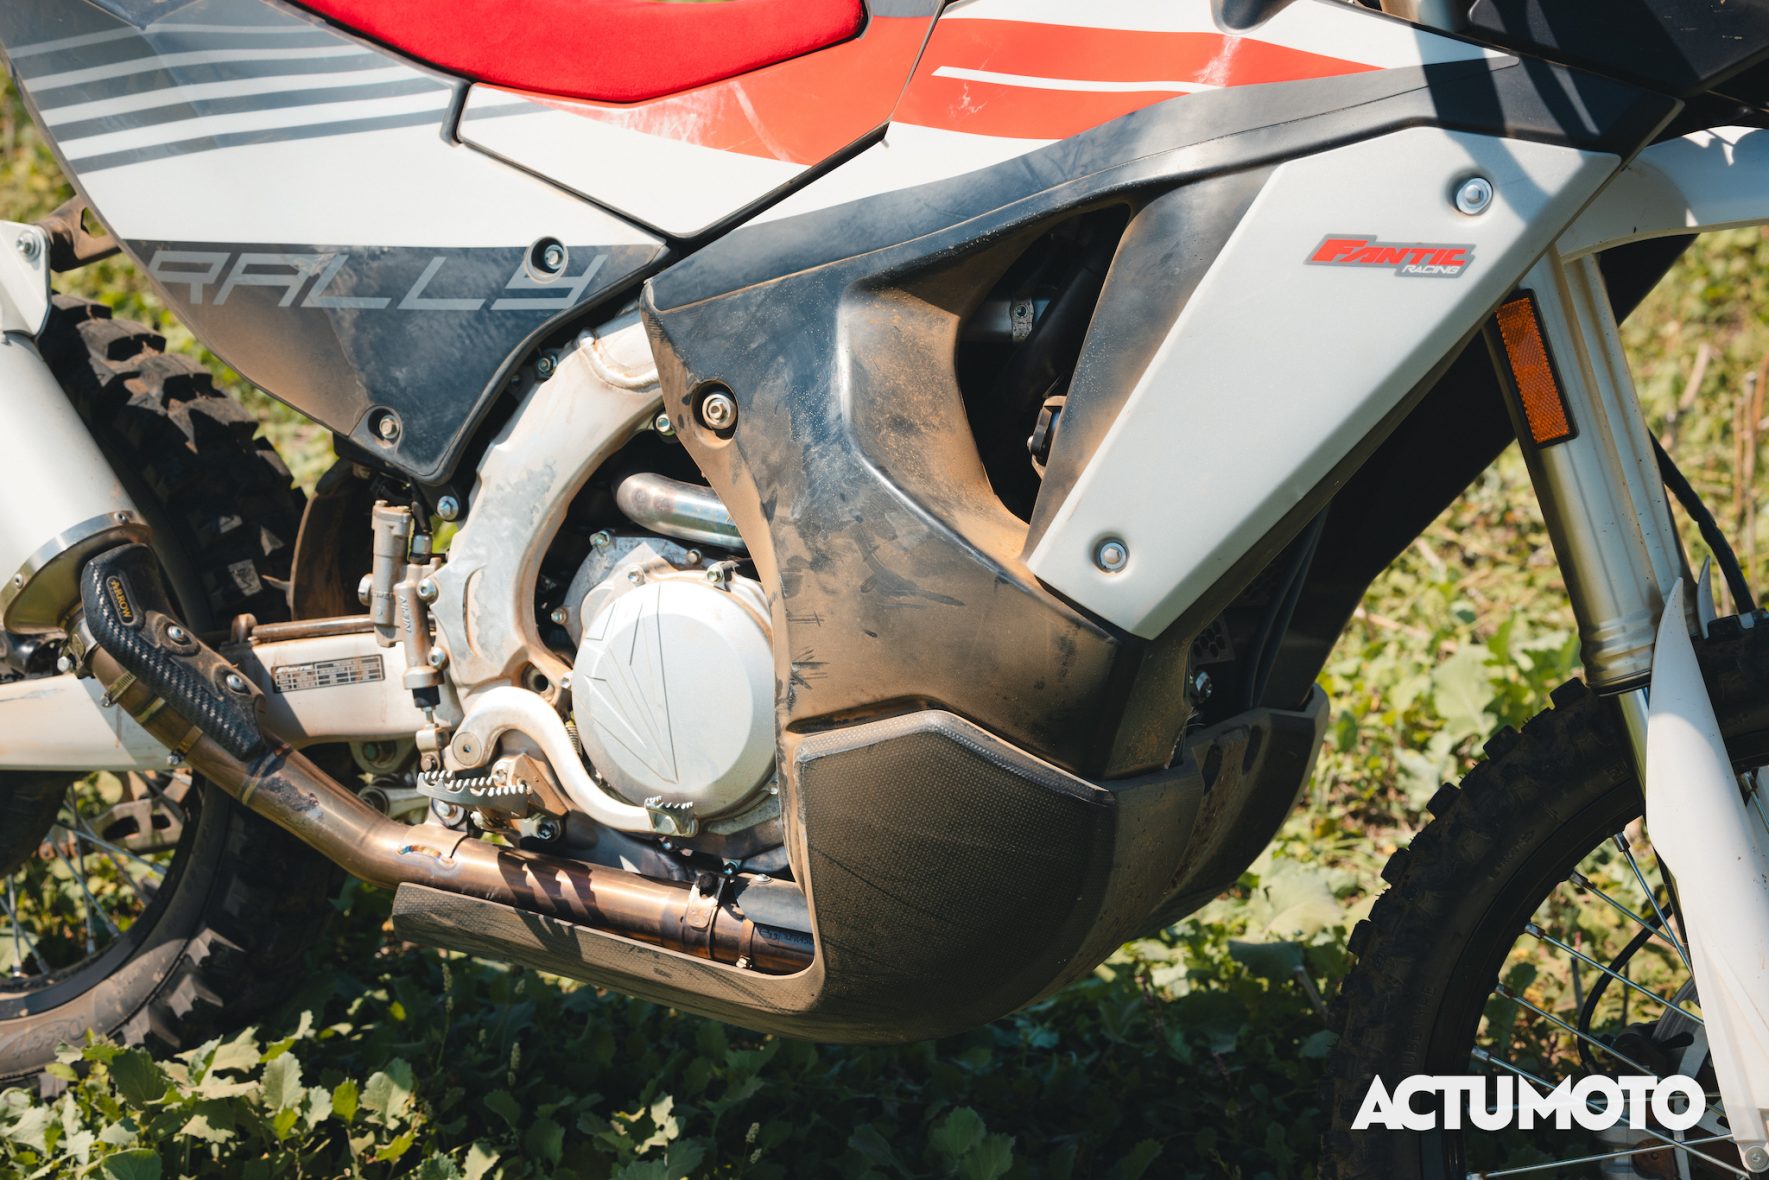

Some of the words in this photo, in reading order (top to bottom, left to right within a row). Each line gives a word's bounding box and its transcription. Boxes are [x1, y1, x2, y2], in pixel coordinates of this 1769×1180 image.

[1311, 239, 1466, 267] FANTIC
[1401, 264, 1461, 275] RACING
[148, 250, 609, 311] RALLY
[110, 580, 133, 618] ARROW
